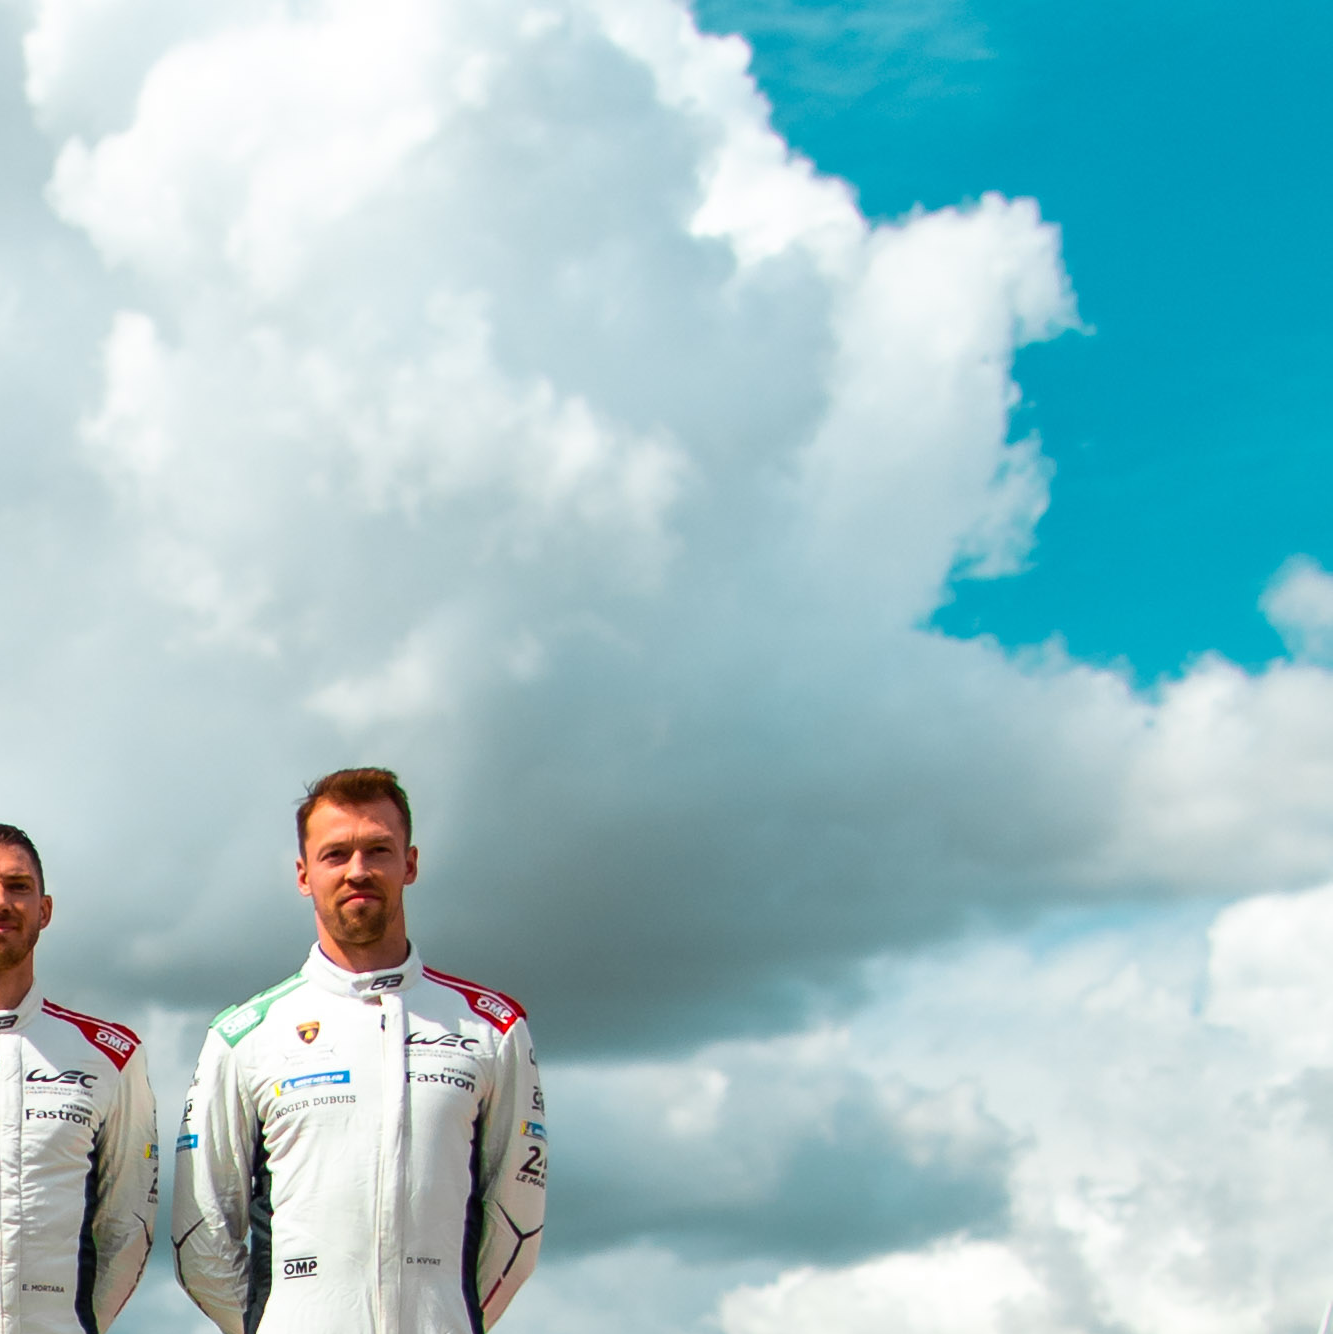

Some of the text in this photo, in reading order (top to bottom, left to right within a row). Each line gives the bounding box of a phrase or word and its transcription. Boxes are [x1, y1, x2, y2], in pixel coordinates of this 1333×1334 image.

[476, 997, 512, 1021] OMP
[96, 1030, 130, 1053] OMP
[404, 1032, 480, 1052] WEC
[25, 1068, 98, 1089] WEC
[406, 1071, 475, 1094] Fastron
[25, 1108, 91, 1127] Fastron
[275, 1095, 357, 1119] ROGER DUBUIS
[284, 1260, 318, 1276] OMP
[31, 1285, 65, 1293] MORTARA
